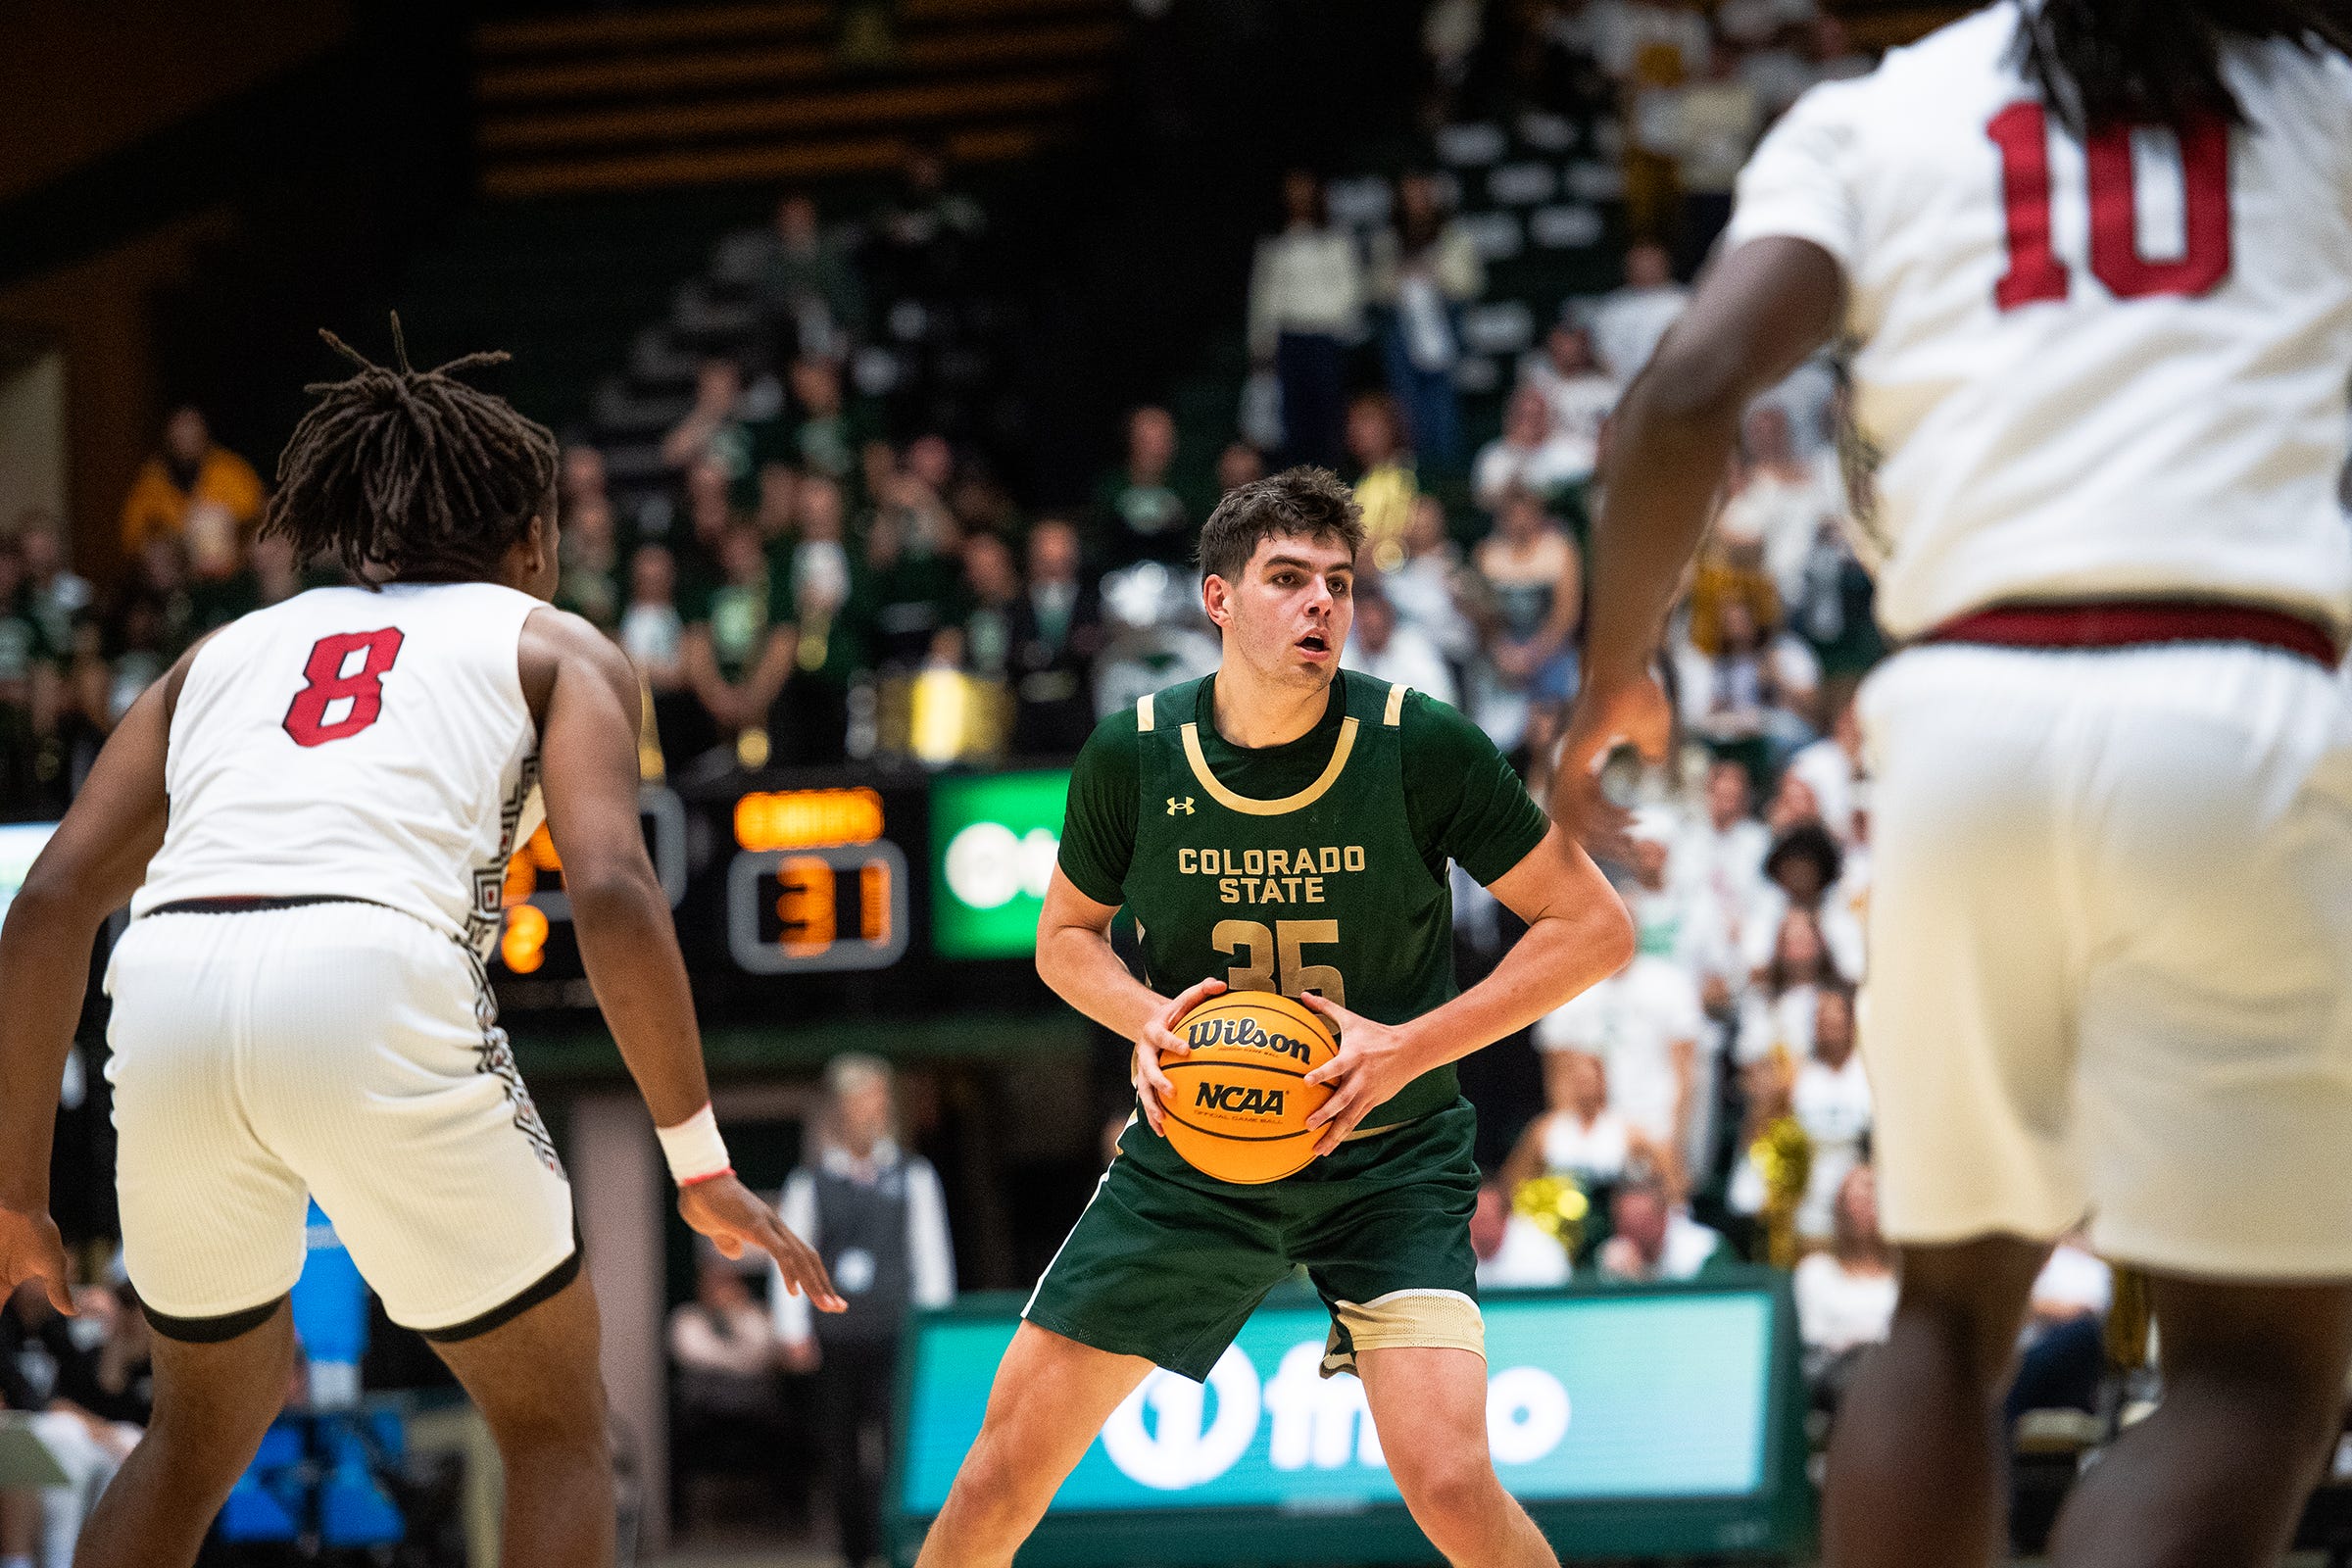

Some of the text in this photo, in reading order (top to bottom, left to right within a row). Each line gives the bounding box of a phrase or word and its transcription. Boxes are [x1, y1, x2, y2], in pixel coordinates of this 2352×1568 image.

[1985, 100, 2230, 314] 10
[281, 625, 406, 749] 8
[1178, 845, 1366, 875] COLORADO
[1218, 876, 1326, 905] STATE
[776, 854, 892, 959] 31
[1211, 918, 1347, 1036] 35
[1188, 1017, 1311, 1066] Wilson
[1195, 1081, 1285, 1115] NCAA
